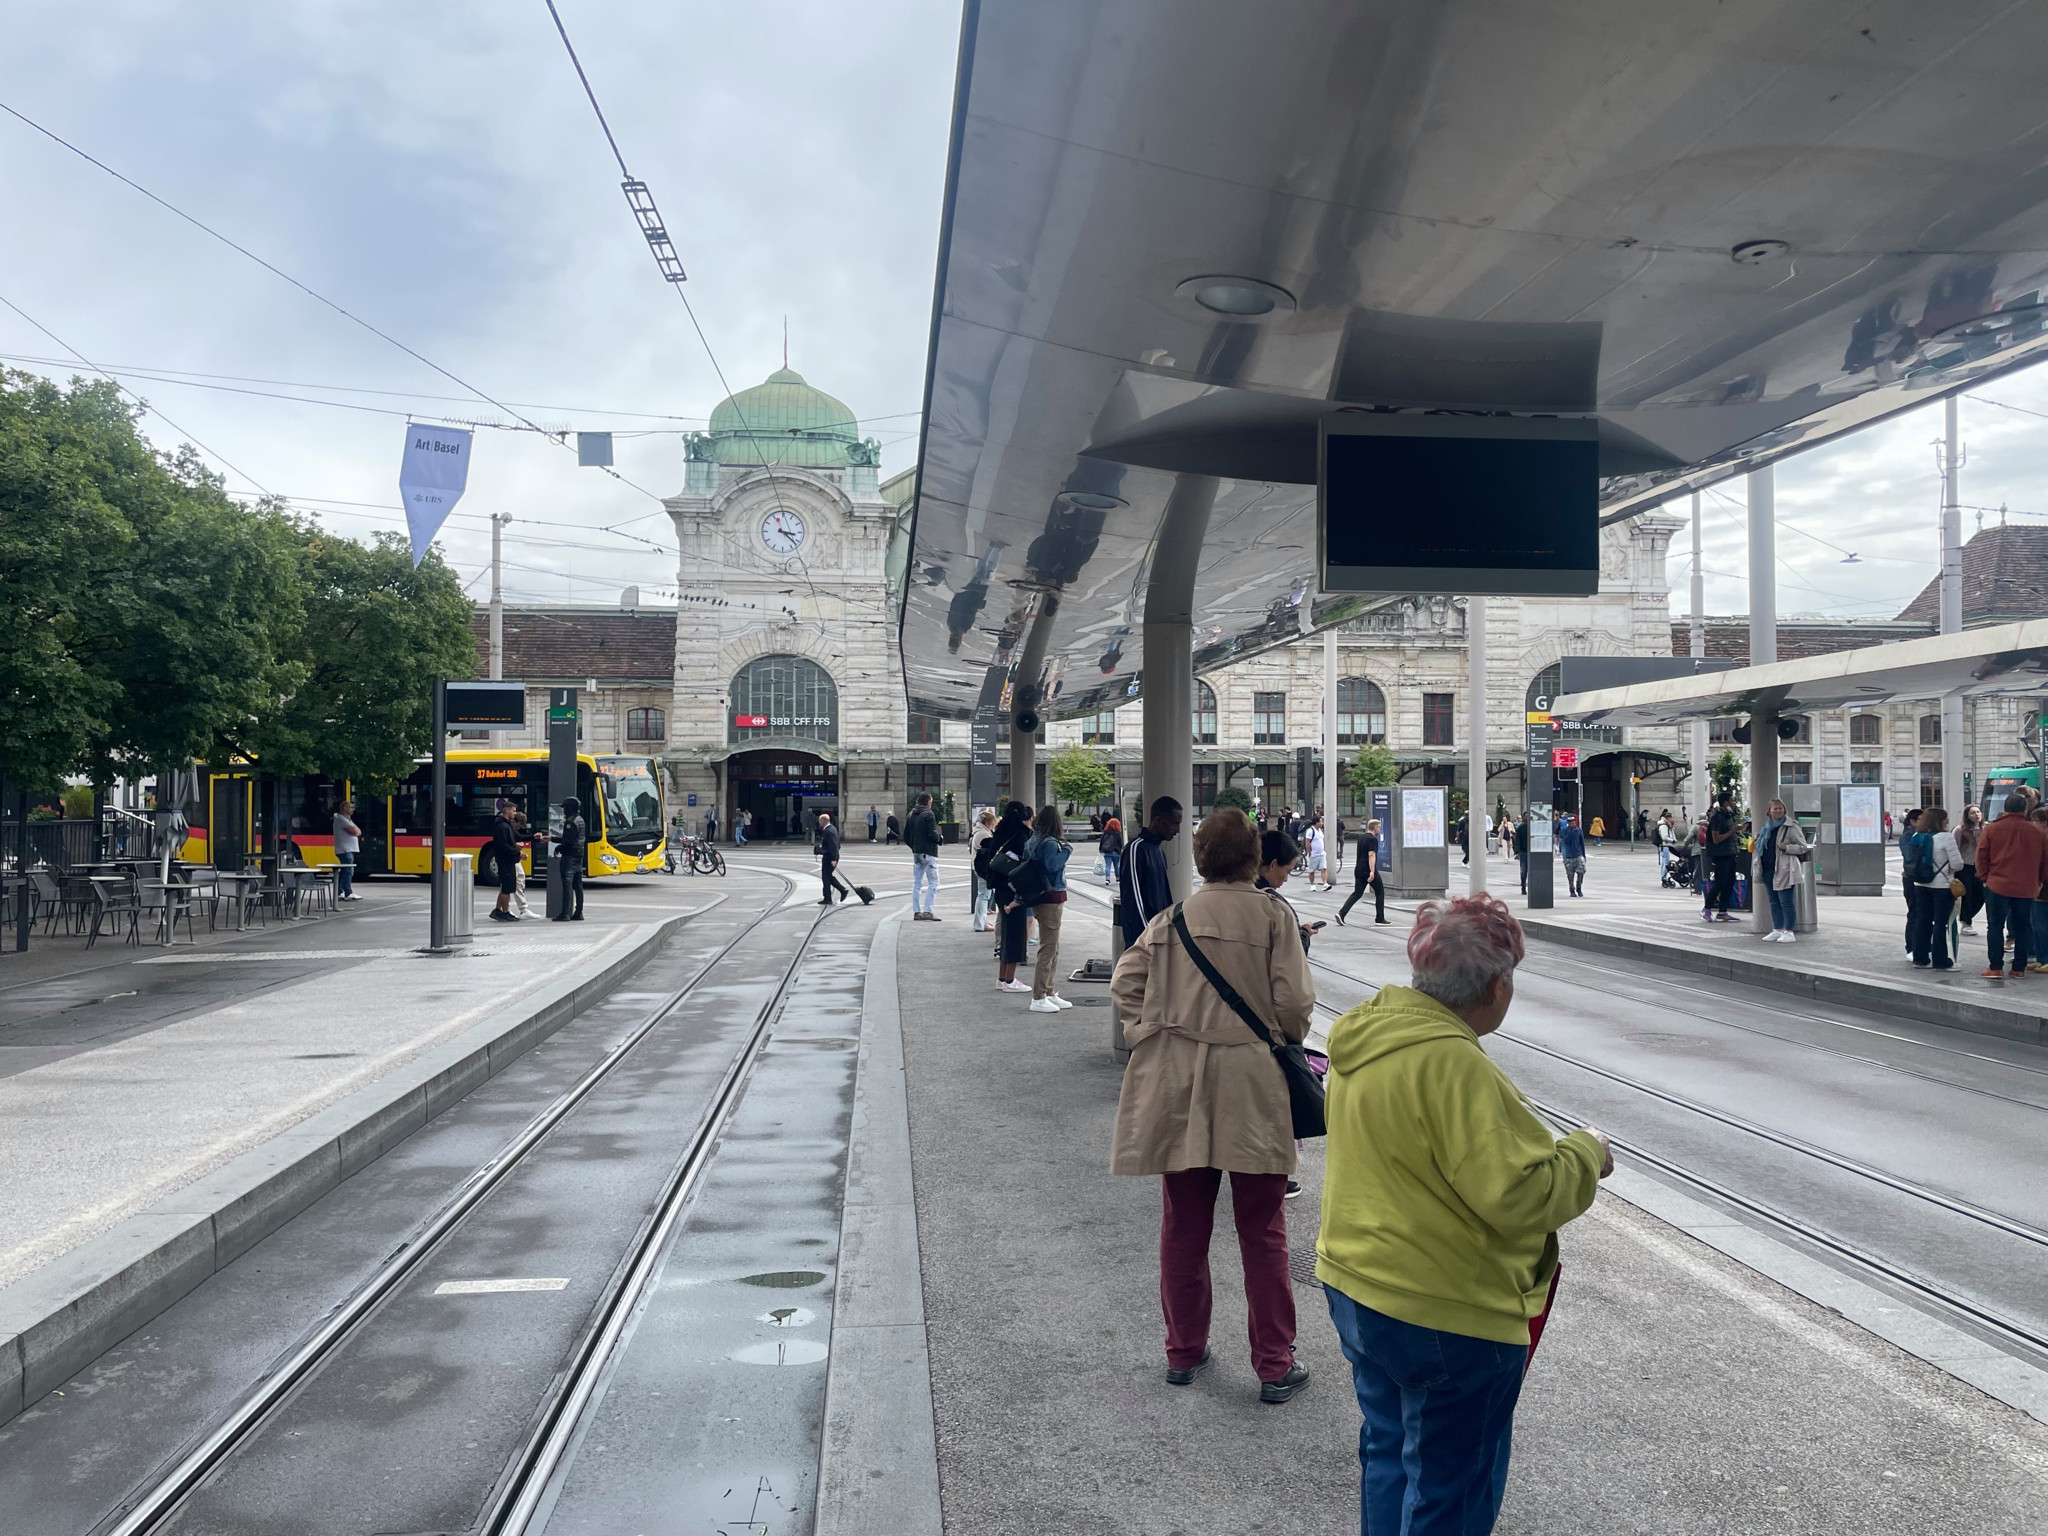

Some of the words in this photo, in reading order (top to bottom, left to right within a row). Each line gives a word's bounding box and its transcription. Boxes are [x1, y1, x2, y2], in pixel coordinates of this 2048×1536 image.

[415, 439, 430, 451] Art
[434, 441, 460, 455] Basel
[559, 690, 568, 706] J
[1535, 695, 1548, 710] G
[770, 717, 790, 726] SBB
[793, 717, 811, 726] CFF
[813, 717, 831, 726] FFS
[1562, 721, 1581, 730] SBB
[477, 769, 486, 779] 37
[486, 769, 506, 778] Bahnhof
[507, 769, 518, 778] SBB
